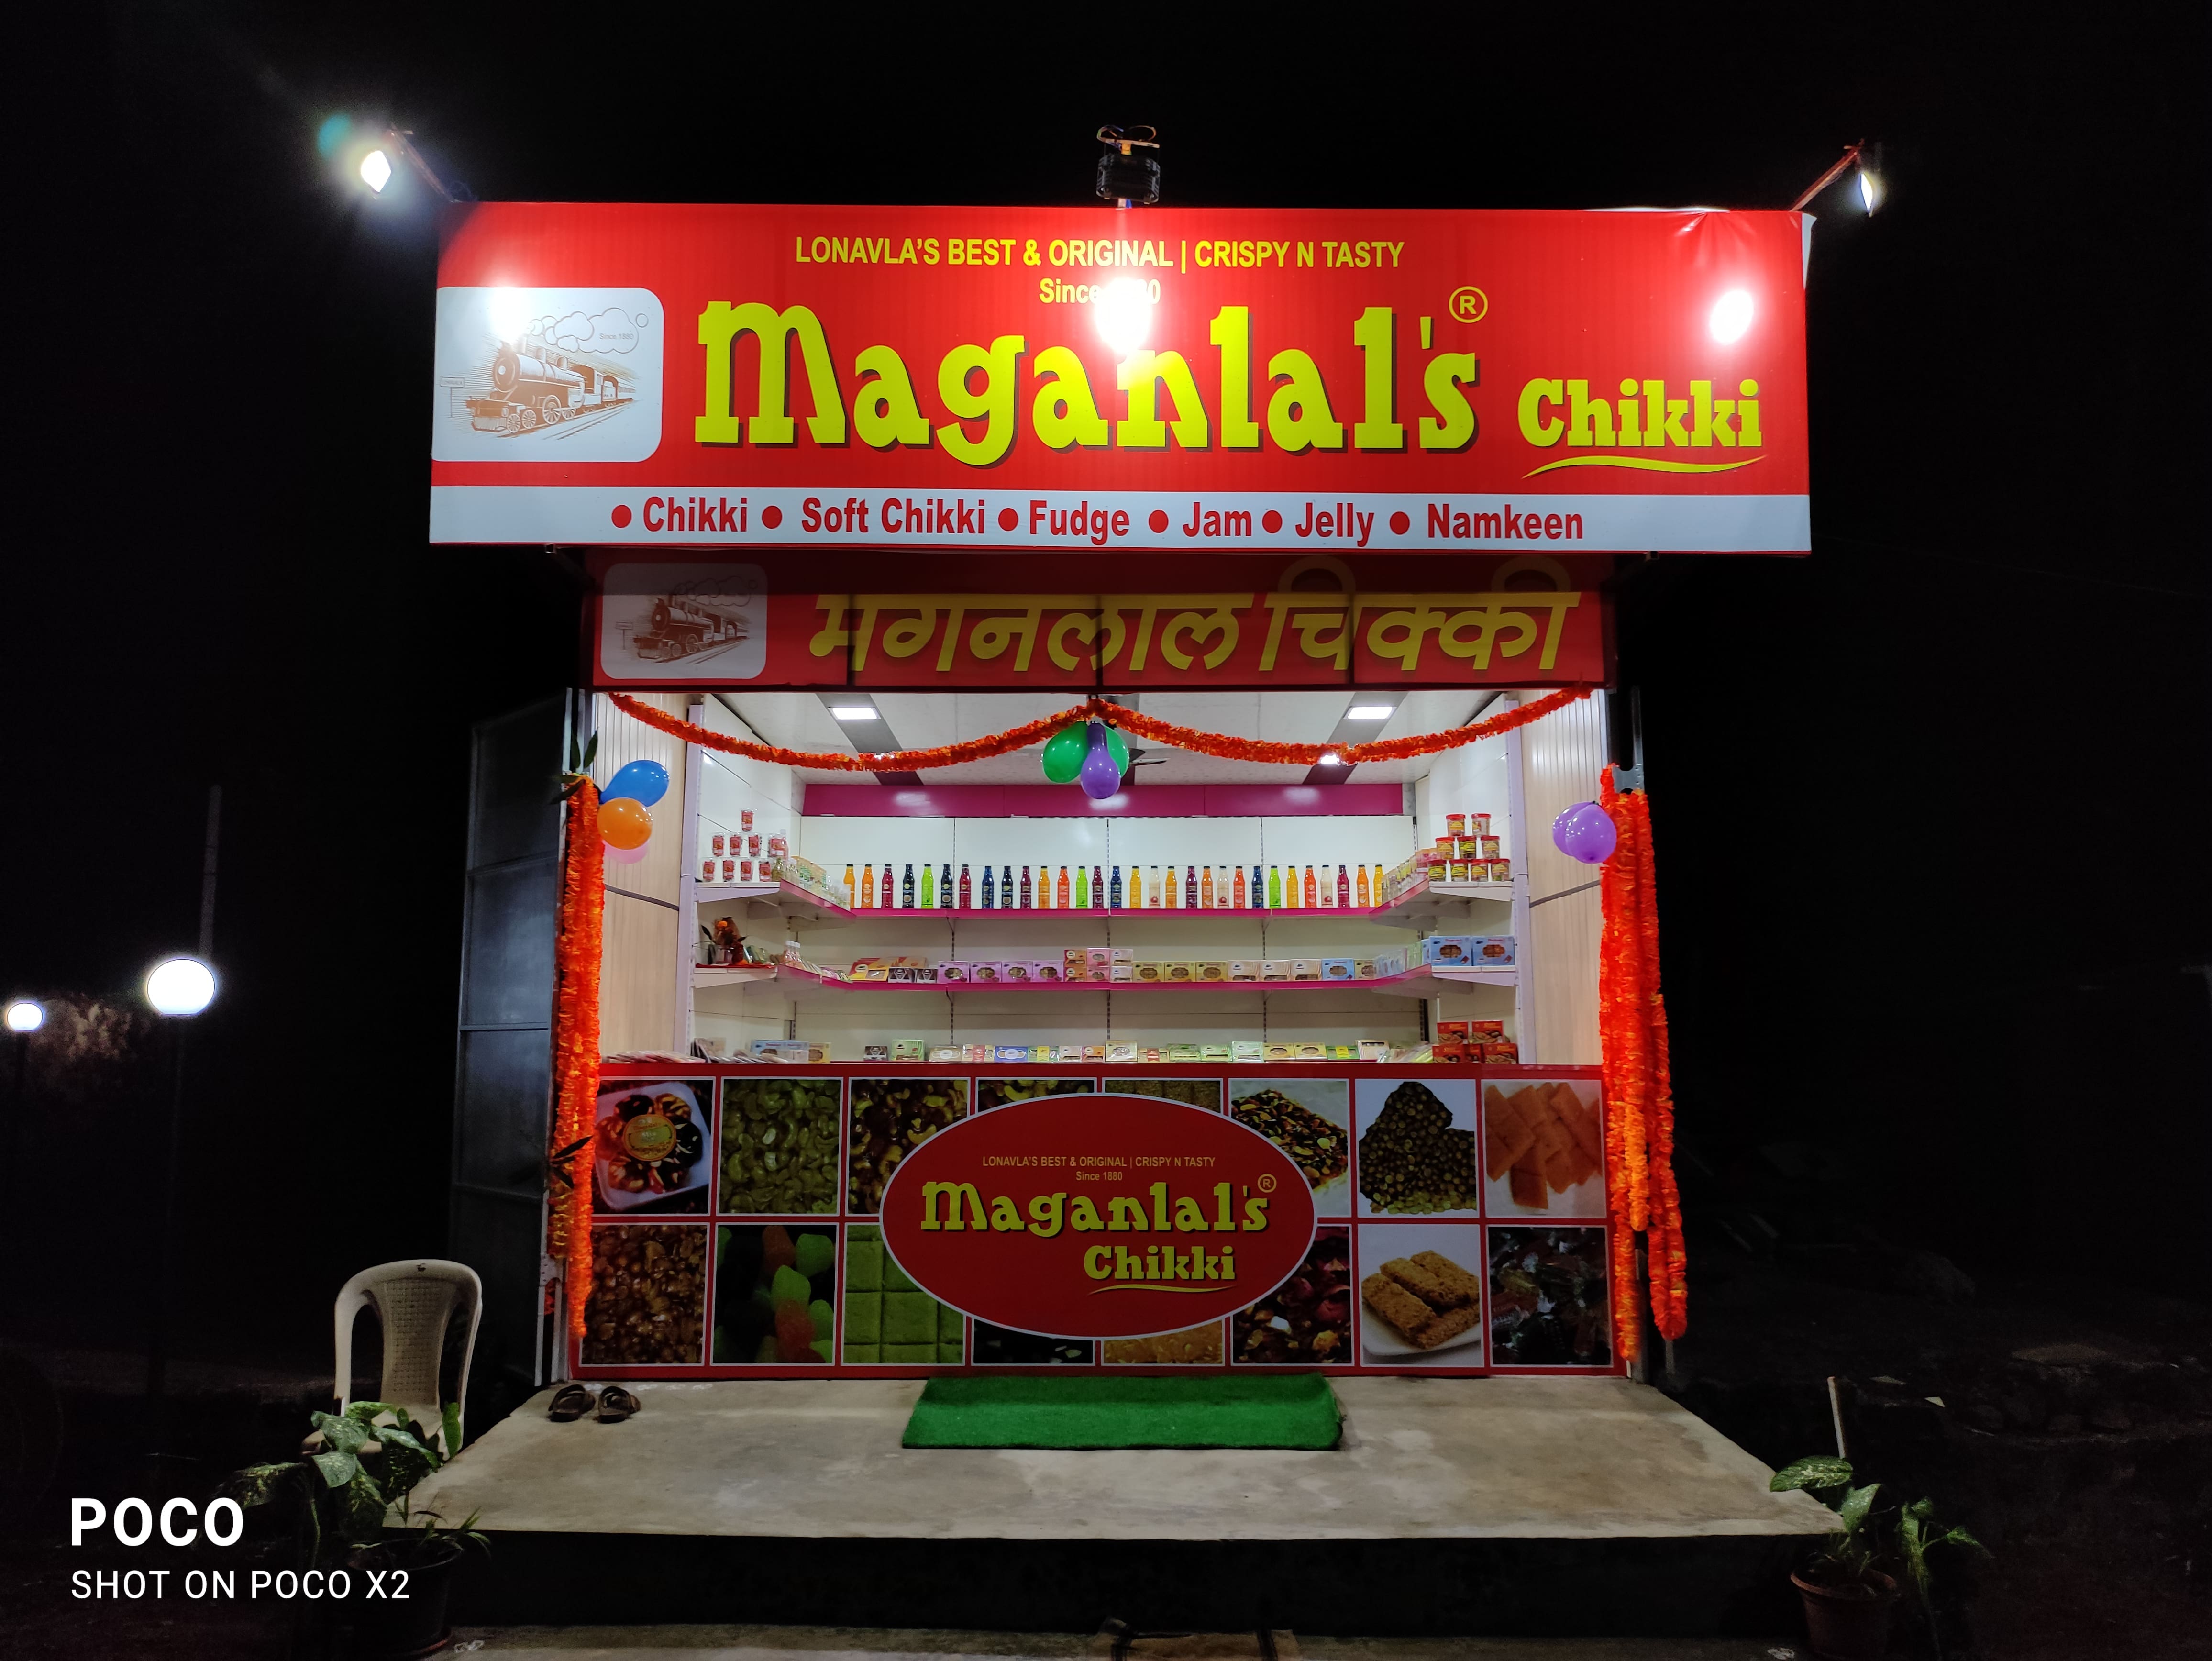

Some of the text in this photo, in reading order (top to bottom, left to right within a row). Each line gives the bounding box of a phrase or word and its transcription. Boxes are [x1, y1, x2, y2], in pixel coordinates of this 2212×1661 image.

[796, 237, 1404, 268] LONAVLA'S BEST & ORIGINAL CRISPY N TASTY
[1039, 277, 1101, 303] Since
[695, 299, 1478, 465] Maganlal's
[1518, 378, 1762, 448] Chikki
[643, 497, 1582, 547] Chikki Soft Chikki Fudge Jam Jelly Namkeen
[808, 555, 1581, 673] मगनलाल चिक्की
[983, 1156, 1215, 1167] LONAVLA'S BEST & ORIGINAL CRISPY N TASTY
[1076, 1171, 1122, 1181] Since 1880
[920, 1181, 1270, 1237] Maganlal's
[1084, 1245, 1236, 1280] Chikki
